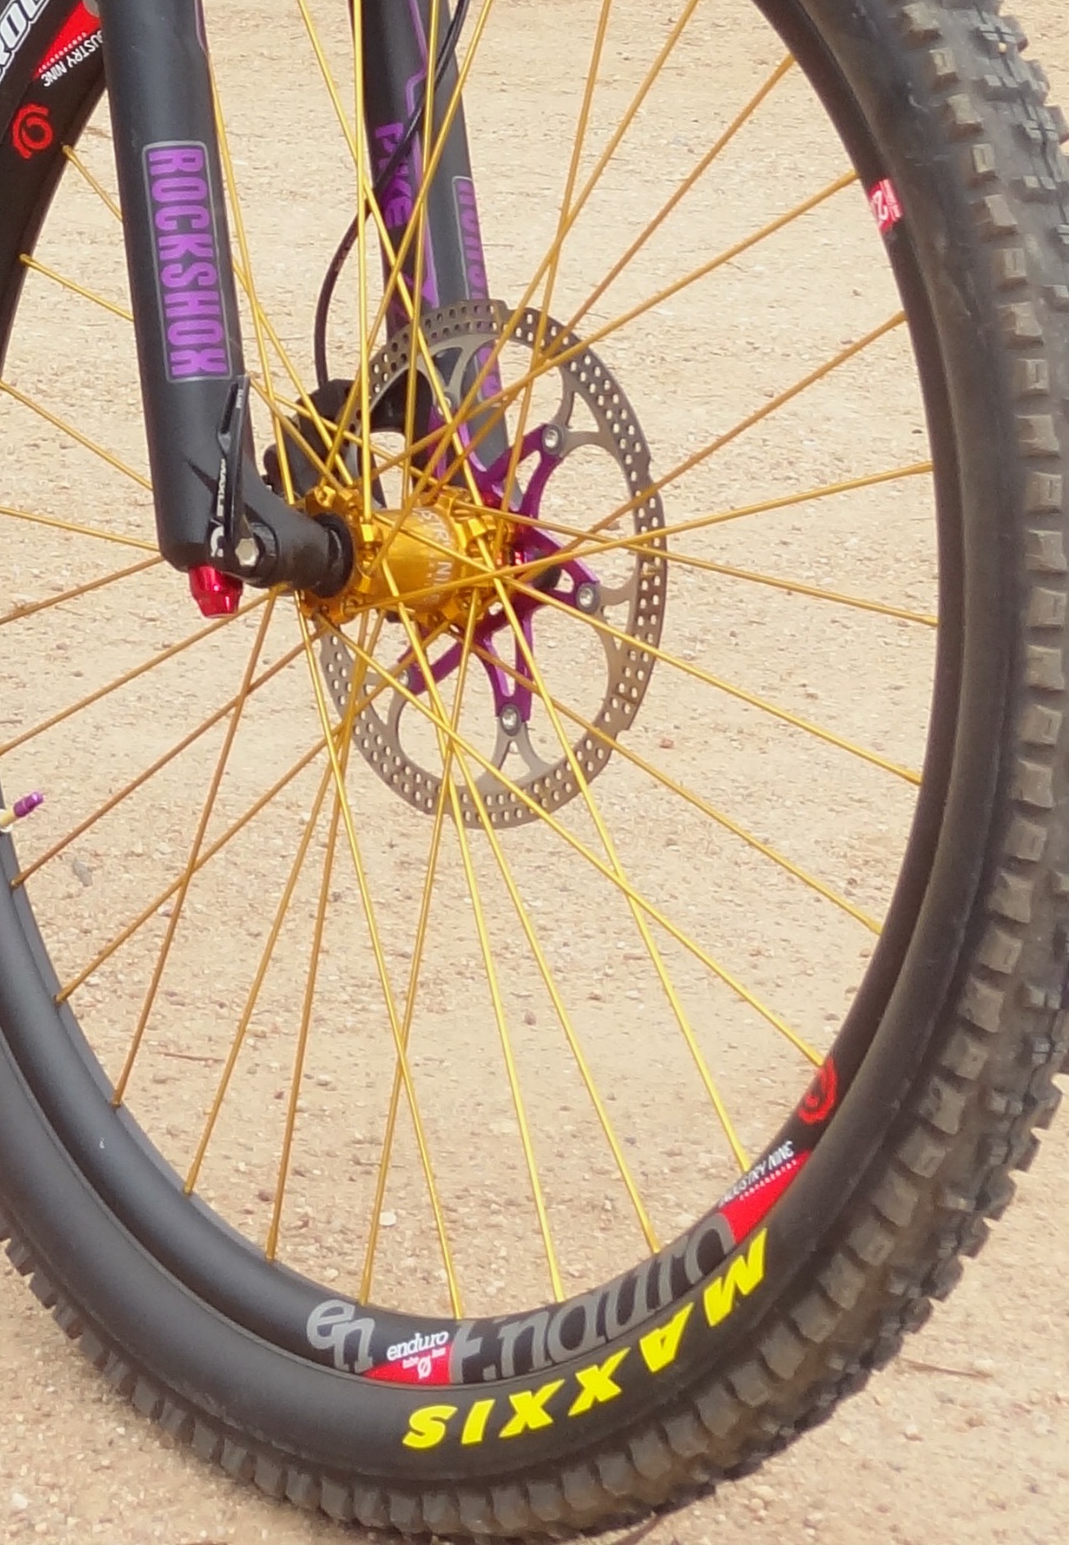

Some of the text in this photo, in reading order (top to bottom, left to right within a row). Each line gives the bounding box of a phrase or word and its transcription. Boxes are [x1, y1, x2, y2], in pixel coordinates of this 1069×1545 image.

[66, 29, 104, 69] USTRY
[40, 57, 68, 88] NINE
[148, 147, 229, 377] ROCKSHOX
[386, 1329, 450, 1364] enduro
[401, 1227, 768, 1450] MAXXIS
